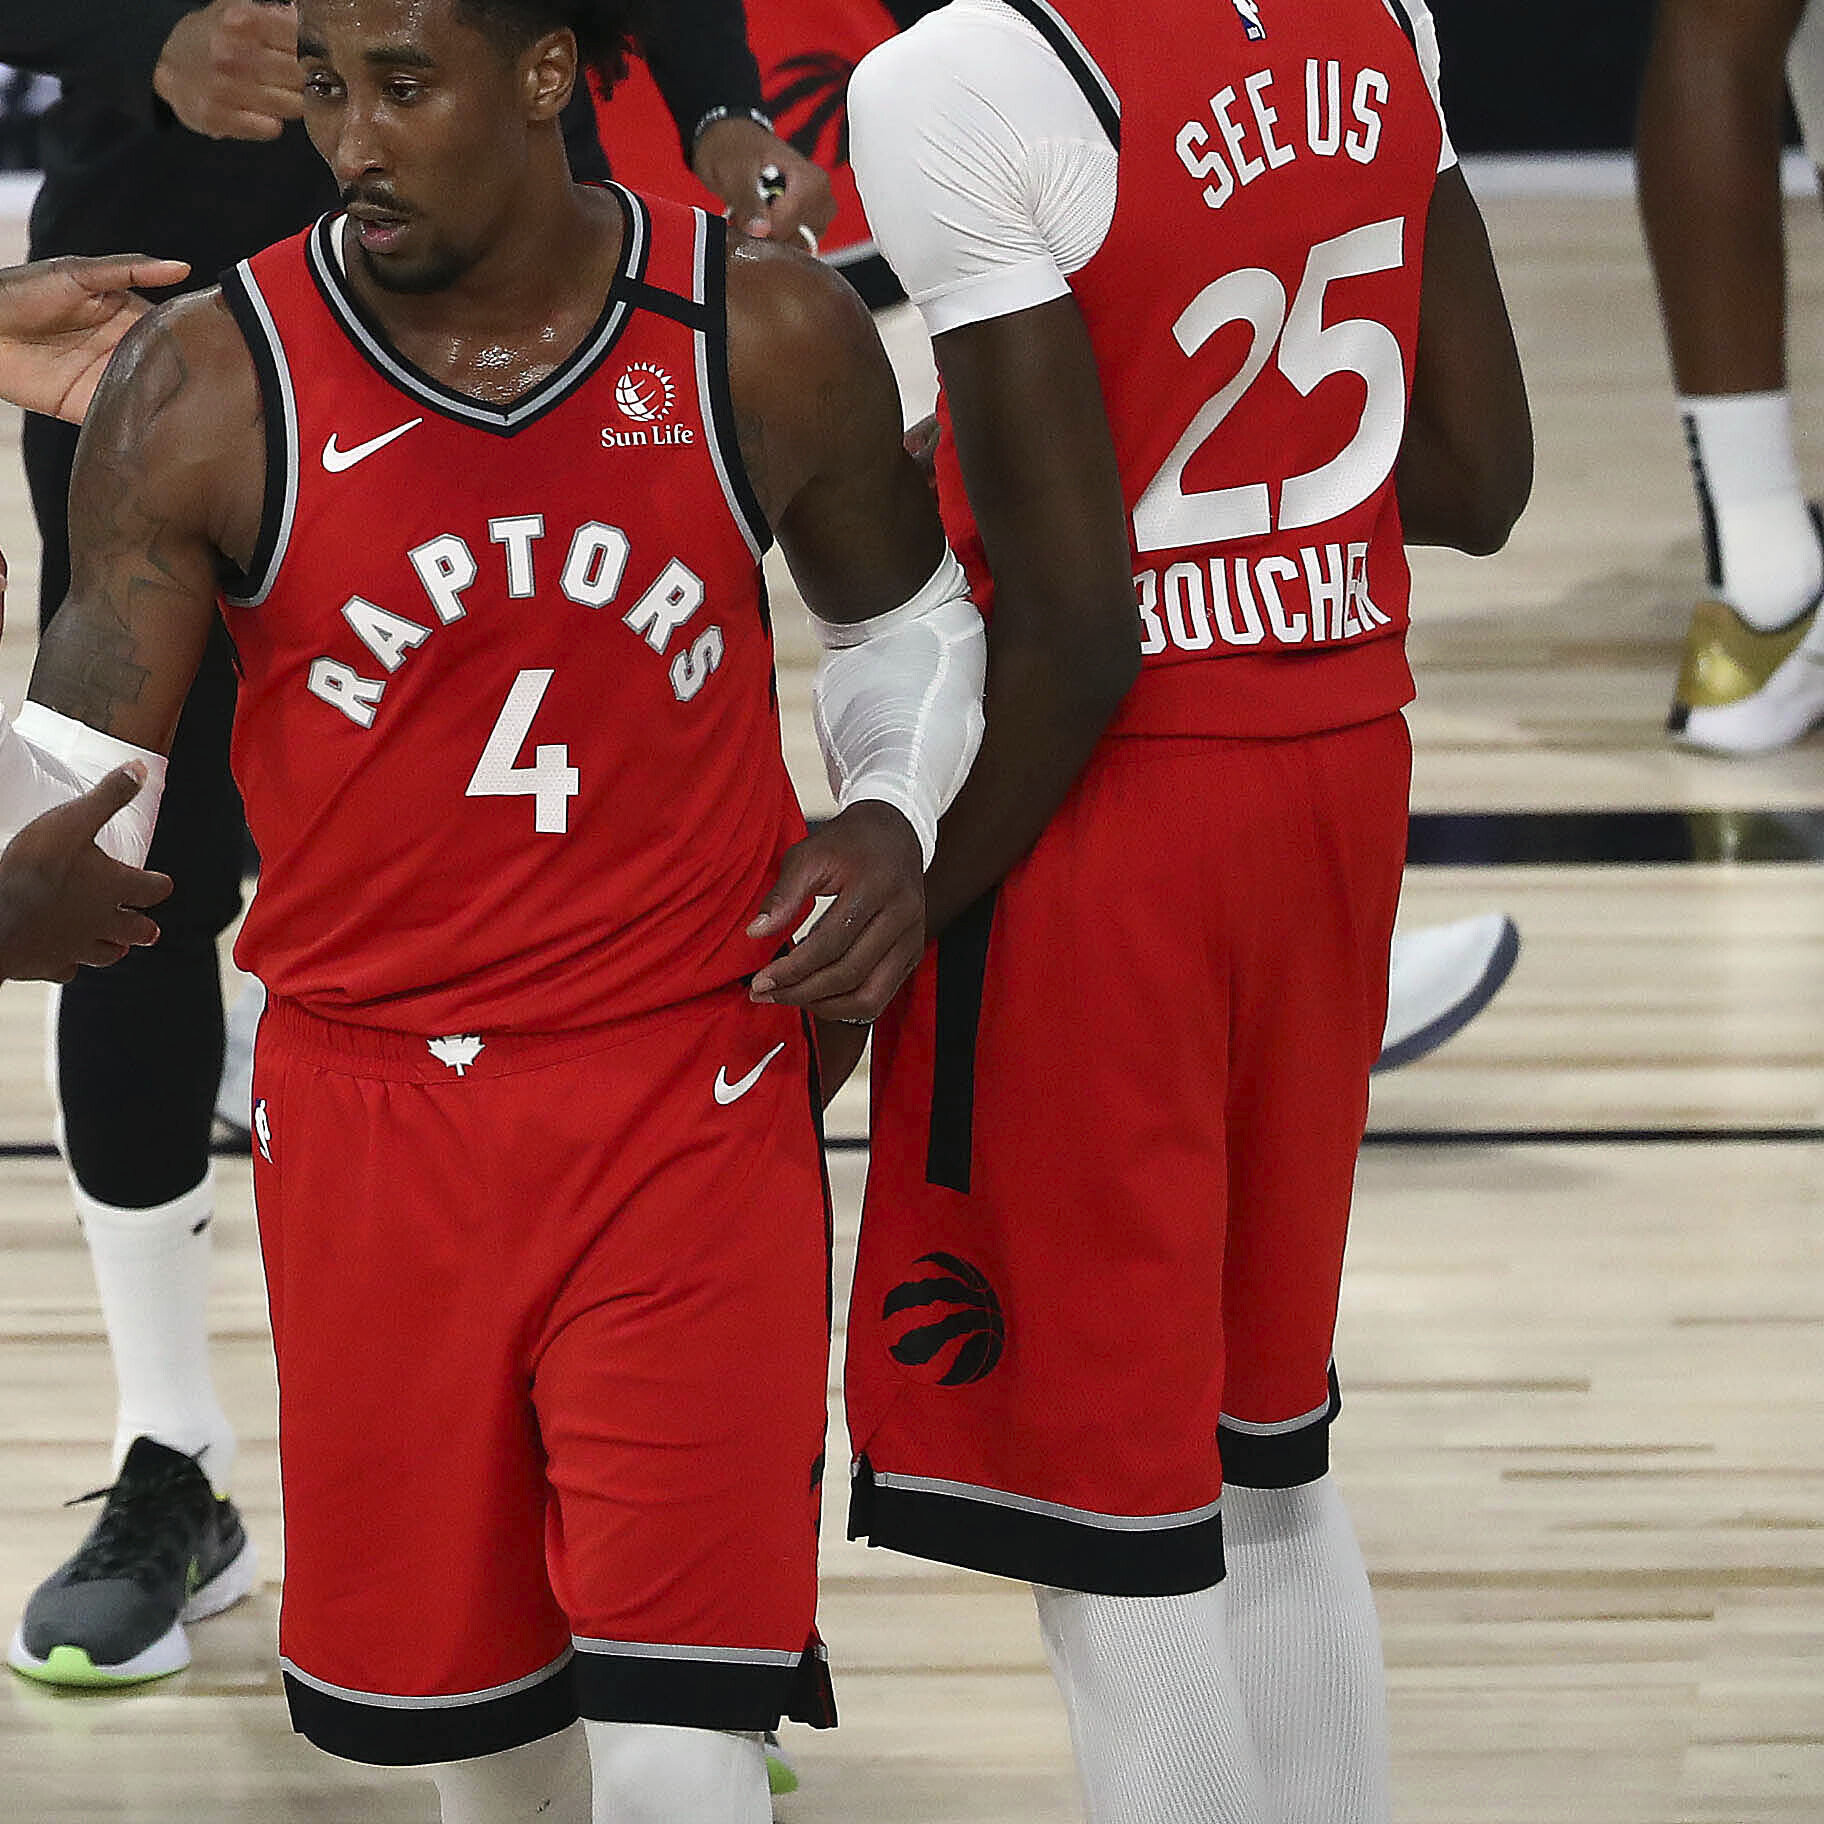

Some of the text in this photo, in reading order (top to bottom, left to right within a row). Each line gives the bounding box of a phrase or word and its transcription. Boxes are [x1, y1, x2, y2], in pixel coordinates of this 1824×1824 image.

[1175, 57, 1390, 209] SEE US
[601, 423, 694, 448] Sun Life
[1131, 216, 1405, 552] 25
[307, 514, 725, 729] RAPTORS
[465, 669, 579, 834] 4
